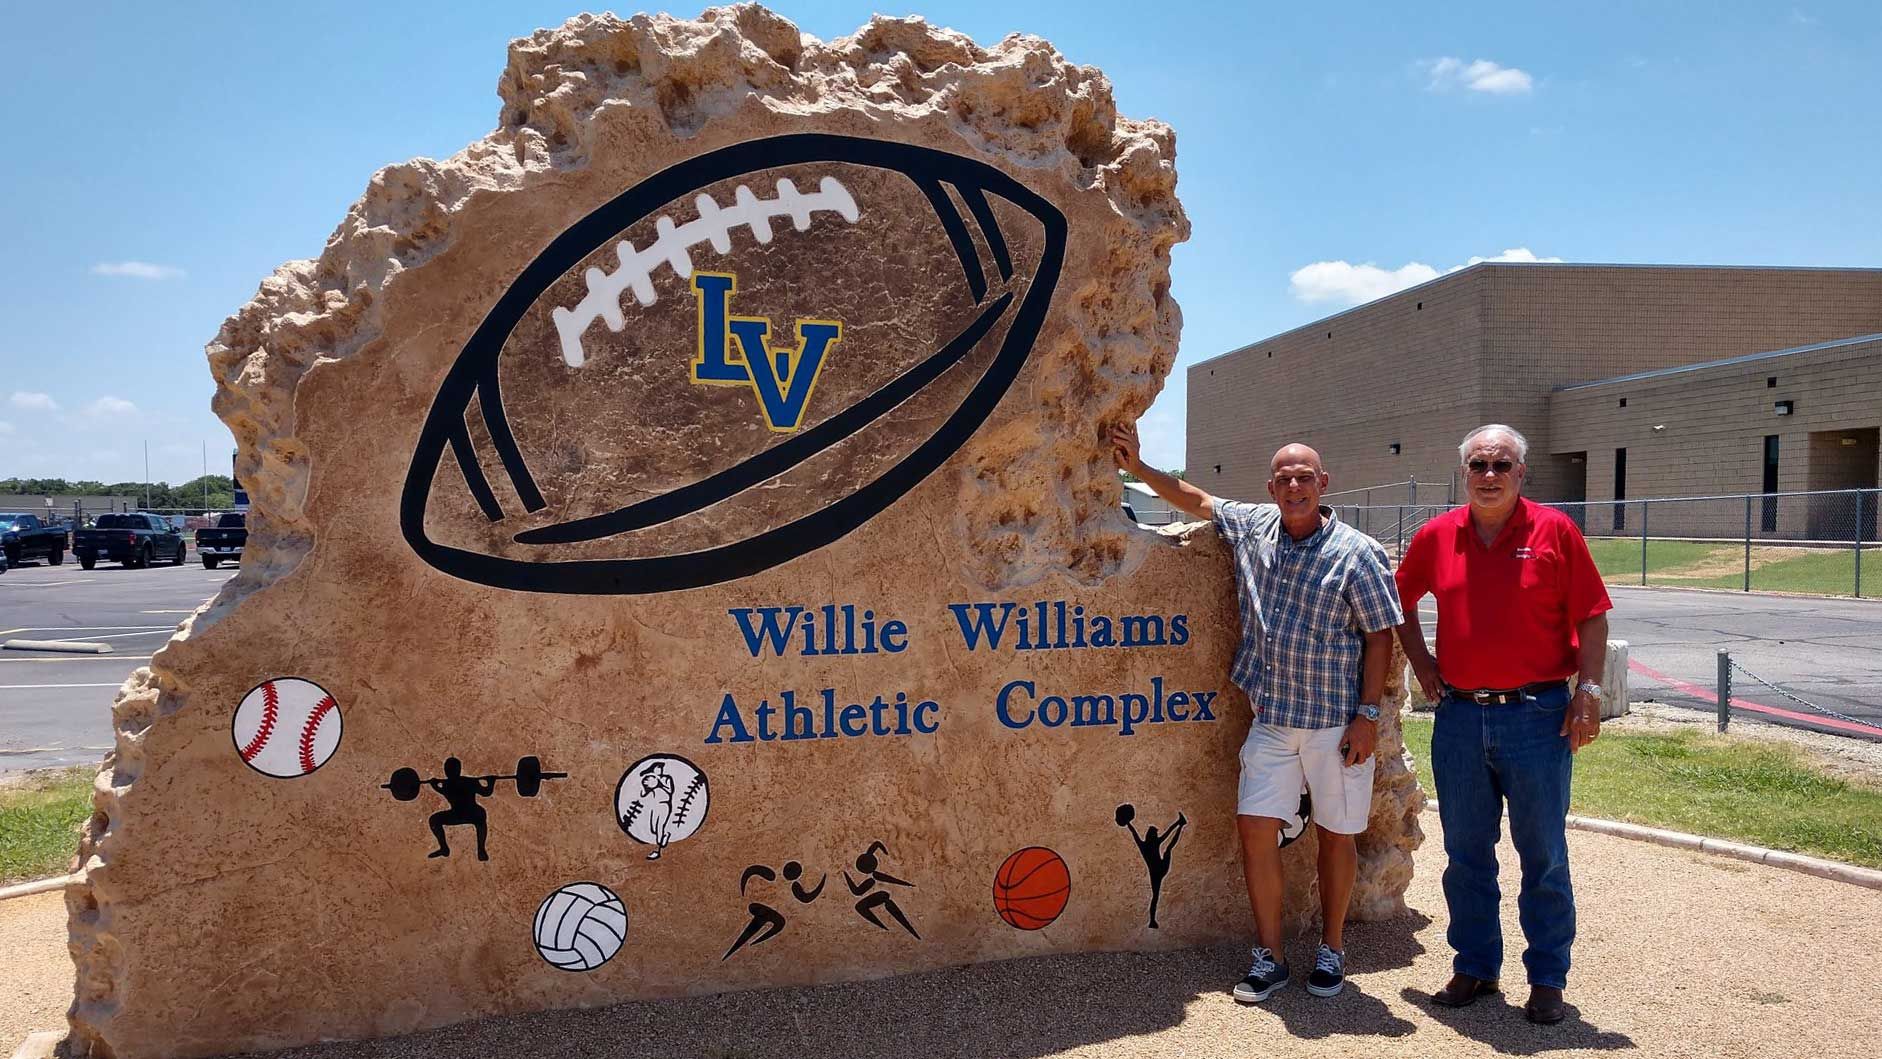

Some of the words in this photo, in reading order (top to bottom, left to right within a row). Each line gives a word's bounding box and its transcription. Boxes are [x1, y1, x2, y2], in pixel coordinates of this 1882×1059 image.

[690, 271, 842, 432] LV
[730, 605, 908, 656] Willie
[949, 602, 1190, 651] Williams
[706, 690, 940, 743] Athletic
[997, 679, 1217, 736] Complex
